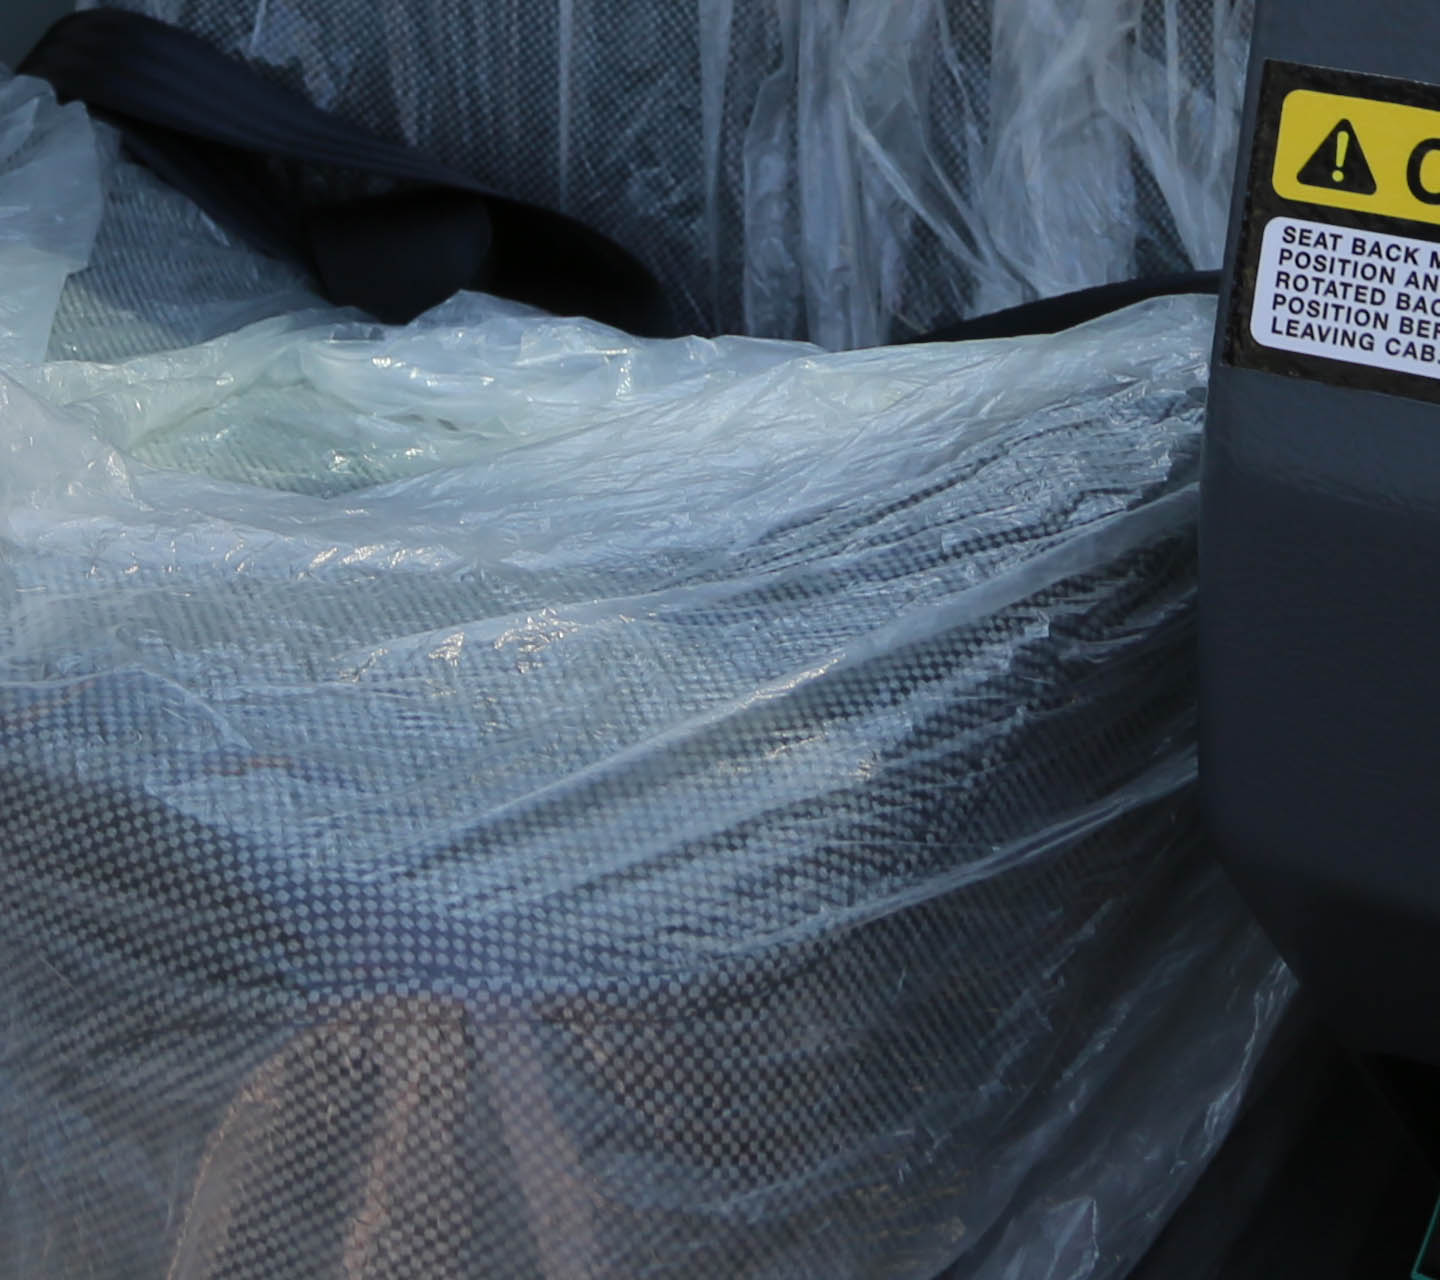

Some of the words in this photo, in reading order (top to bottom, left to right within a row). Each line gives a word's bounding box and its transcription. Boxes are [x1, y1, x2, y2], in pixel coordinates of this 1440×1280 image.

[1281, 224, 1343, 252] SEAT
[1350, 236, 1420, 266] BACK
[1277, 247, 1396, 285] POSITION
[1274, 269, 1386, 306] ROTATED
[1271, 292, 1389, 331] POSITION
[1270, 315, 1375, 352] LEAVING
